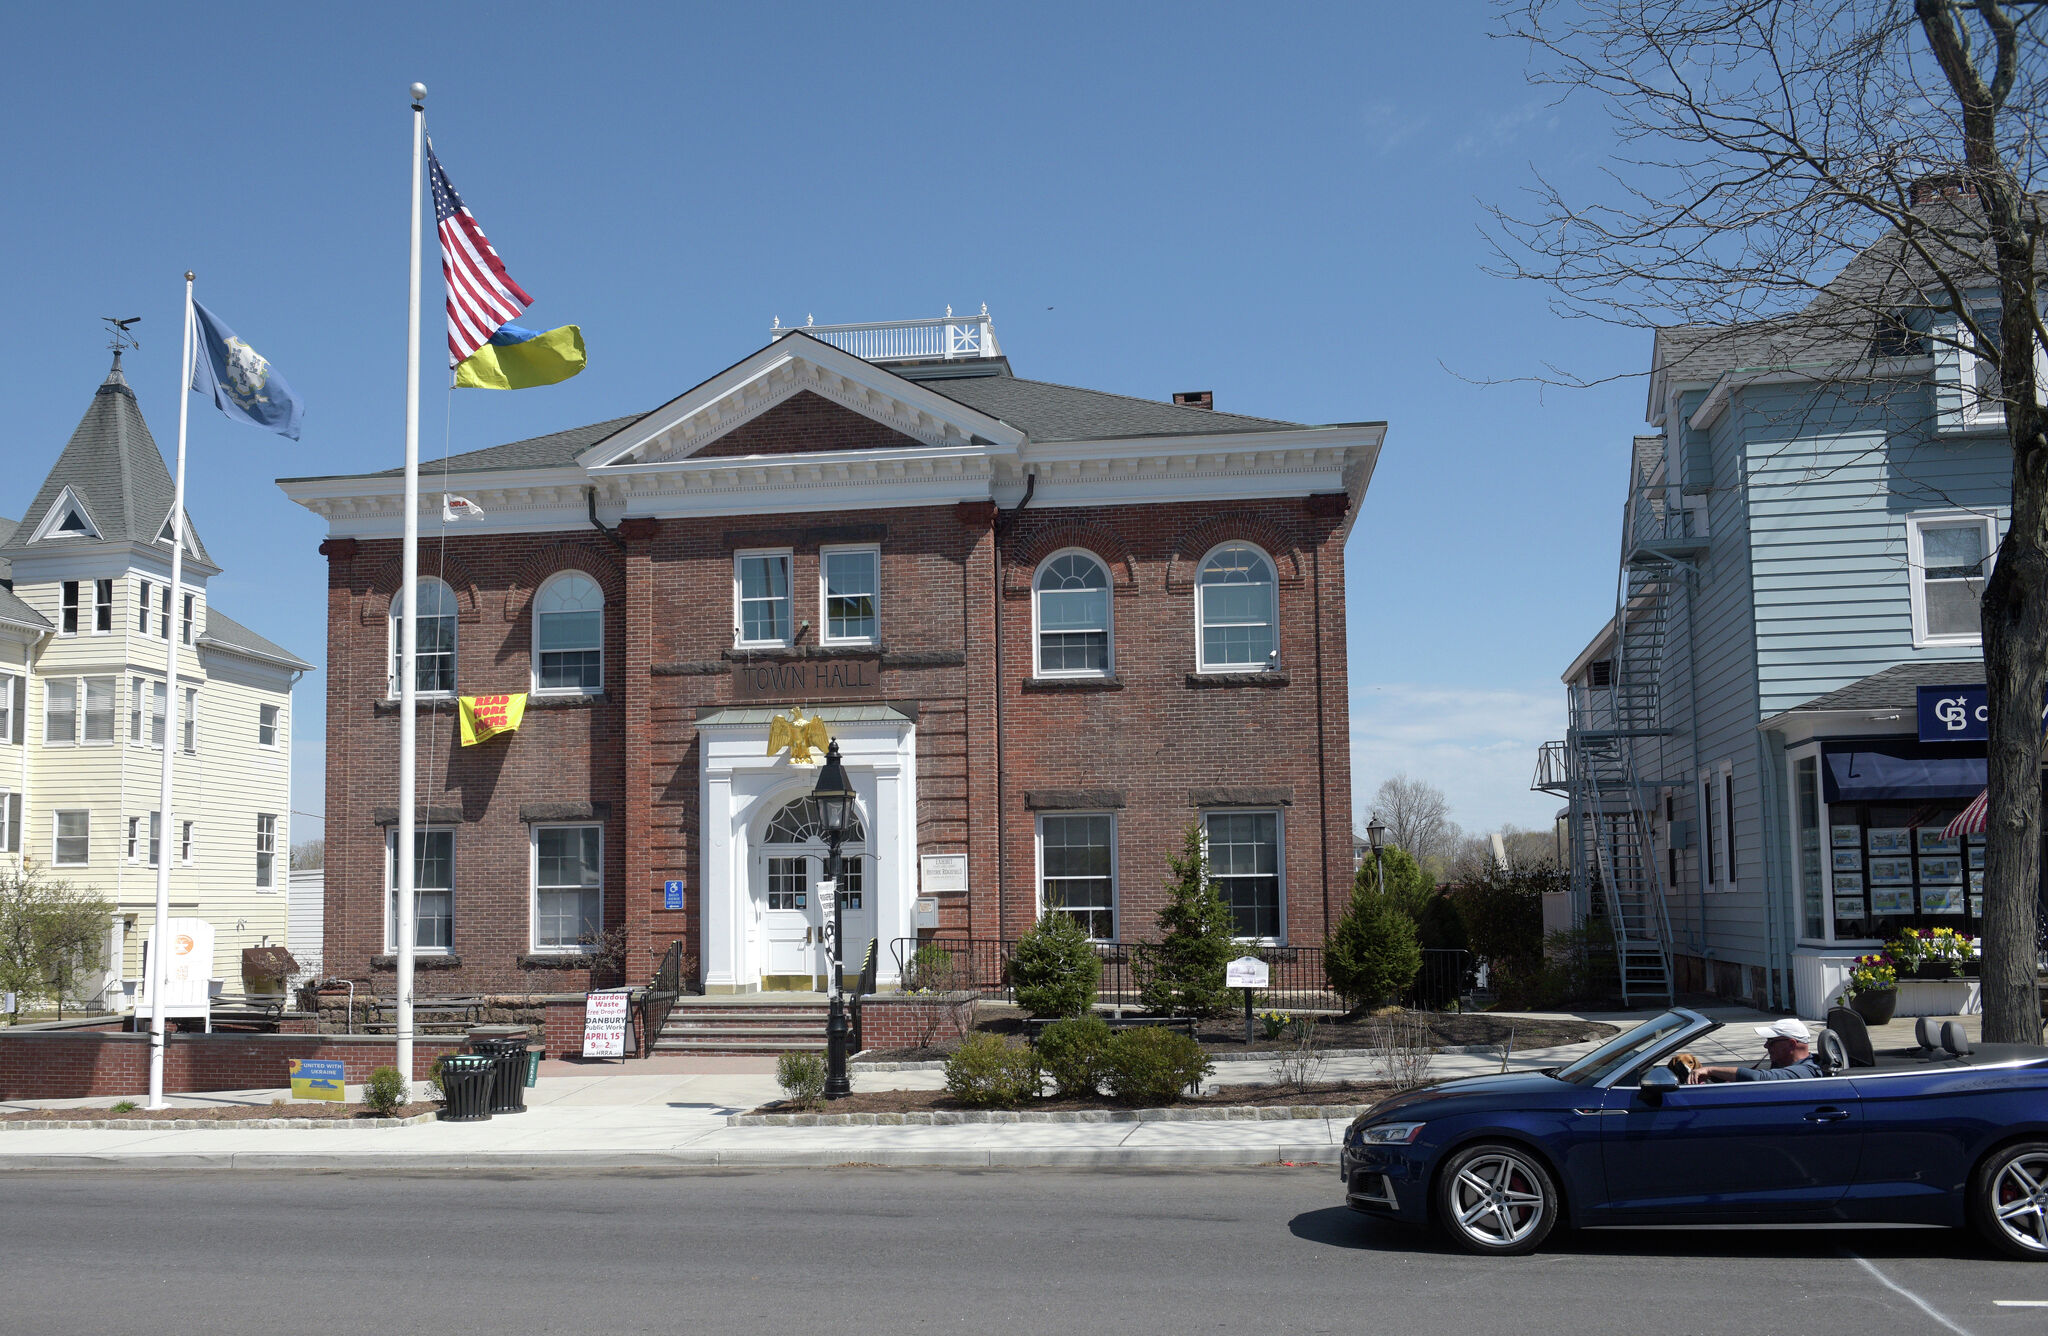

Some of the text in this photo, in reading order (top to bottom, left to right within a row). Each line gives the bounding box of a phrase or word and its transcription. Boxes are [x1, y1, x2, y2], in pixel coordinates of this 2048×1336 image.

[742, 665, 805, 692] TOWN
[475, 696, 510, 706] READ
[473, 706, 507, 720] MORE
[585, 1032, 608, 1040] APRIL
